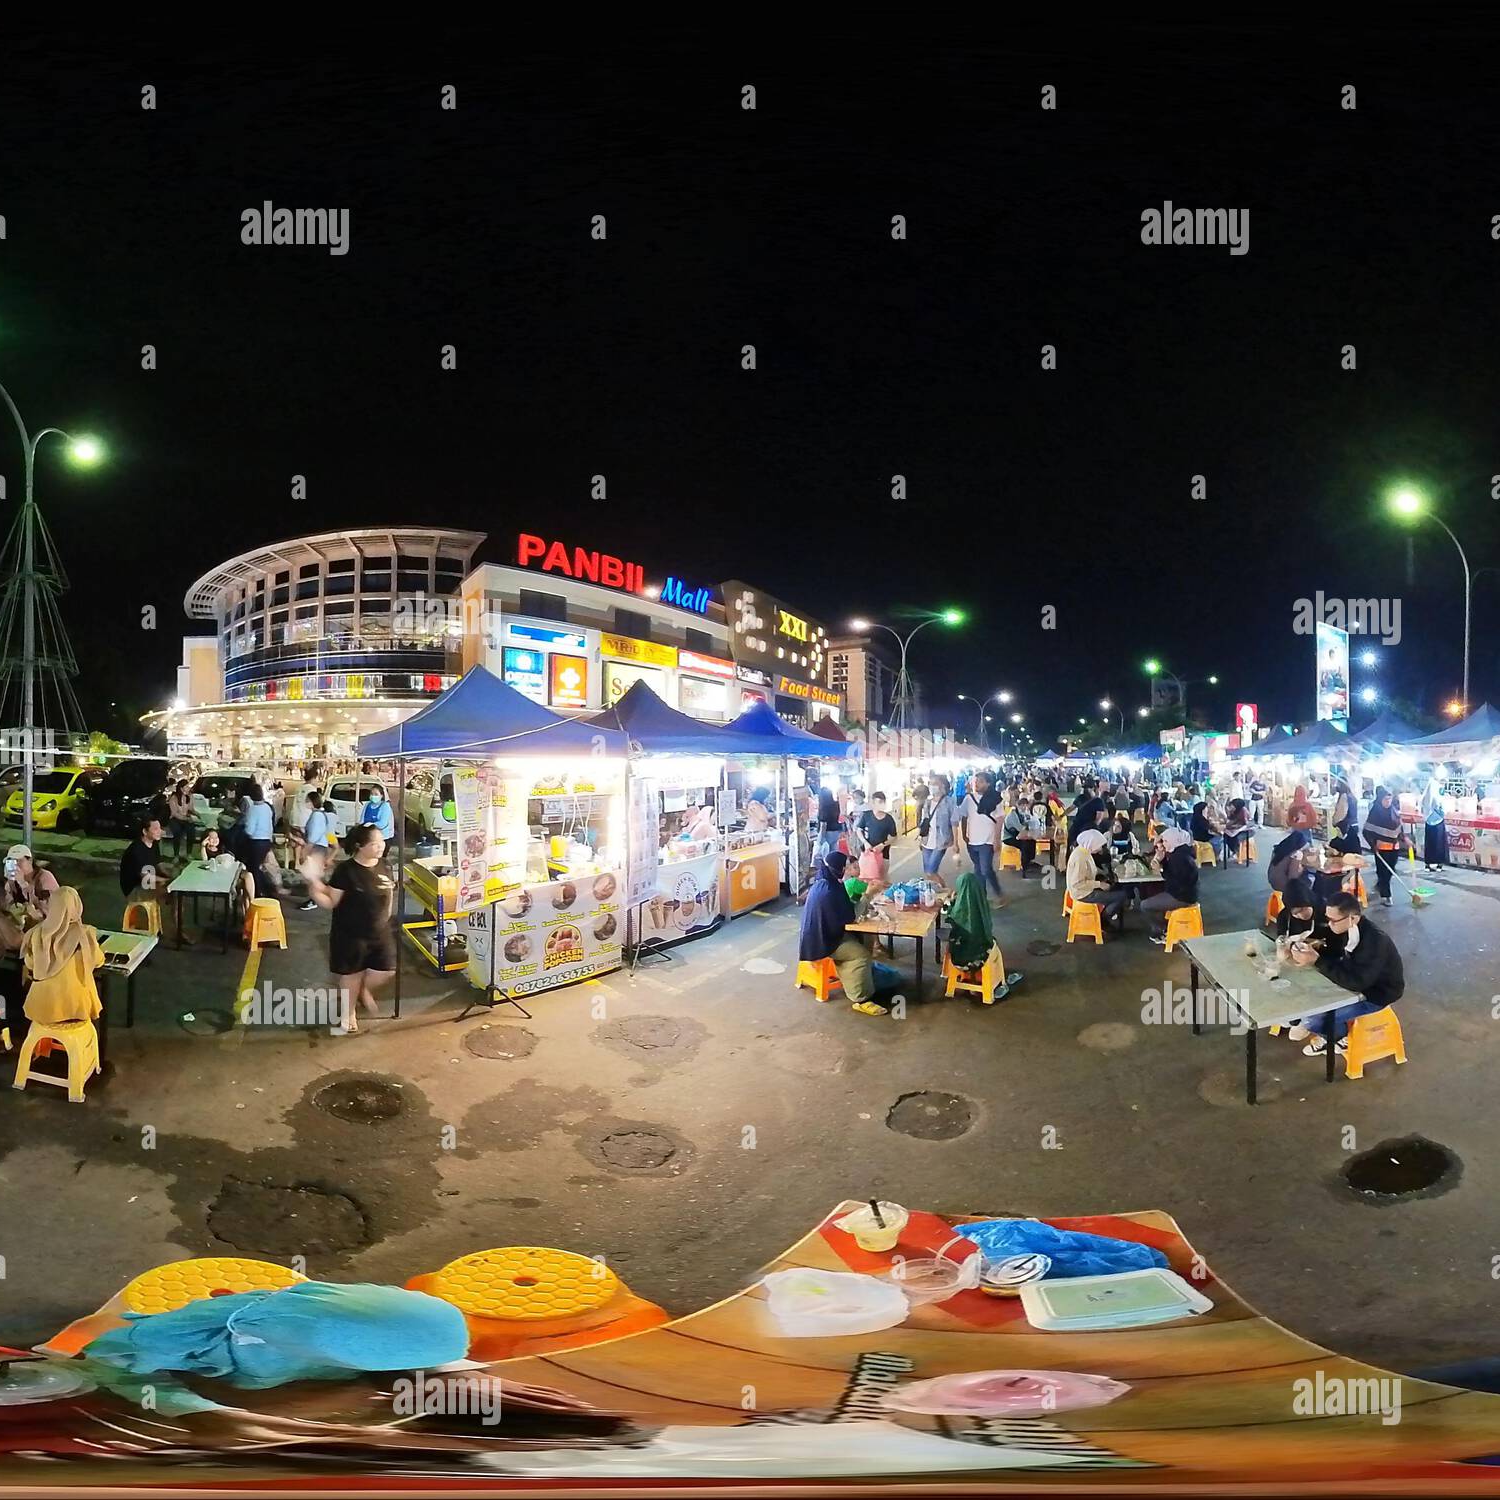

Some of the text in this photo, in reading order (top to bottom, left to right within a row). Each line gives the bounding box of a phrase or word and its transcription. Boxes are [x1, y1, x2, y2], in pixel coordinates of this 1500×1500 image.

[660, 576, 709, 613] Mall
[778, 609, 808, 641] XXI
[779, 676, 809, 698] Food
[811, 685, 841, 704] Street
[543, 954, 584, 970] POPCORN
[544, 947, 584, 963] CHICKEN
